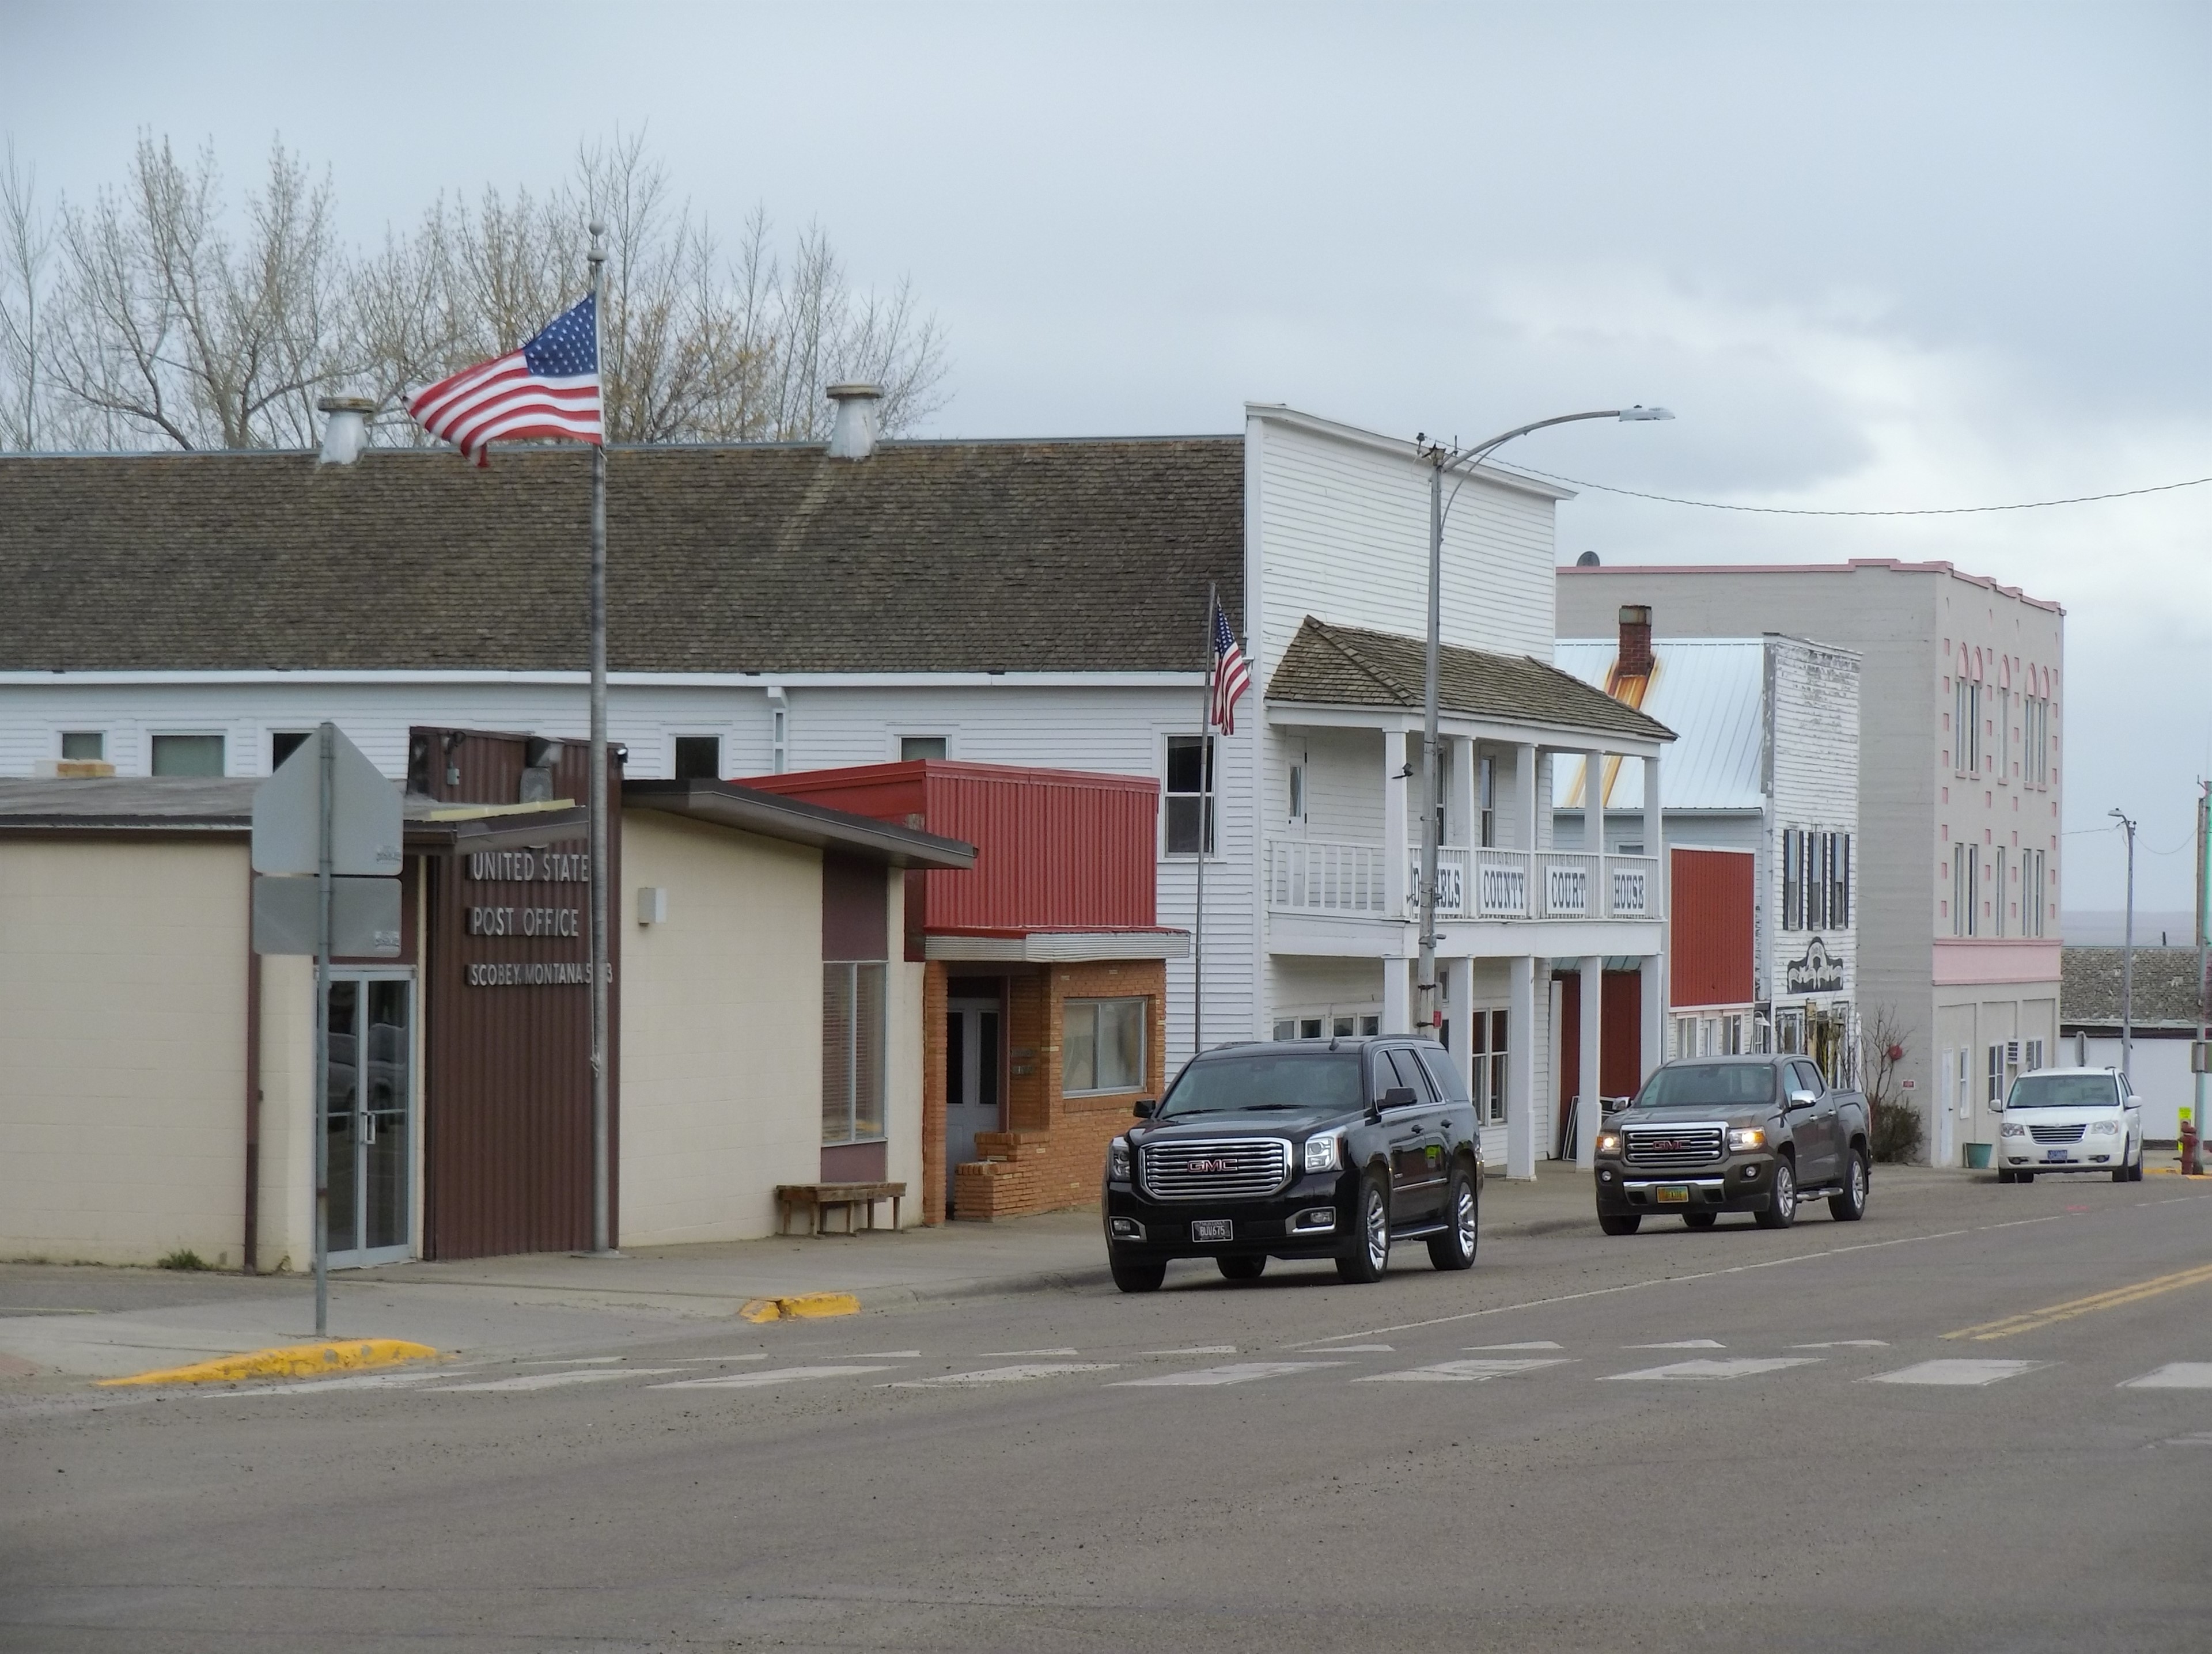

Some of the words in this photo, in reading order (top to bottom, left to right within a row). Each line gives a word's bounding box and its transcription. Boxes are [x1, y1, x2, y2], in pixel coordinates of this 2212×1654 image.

[473, 852, 535, 881] UNITED
[543, 854, 589, 882] STATE
[1483, 870, 1524, 909] COUNTY
[1552, 871, 1585, 908] COURT
[1613, 874, 1643, 909] HOUSE
[473, 906, 514, 936] POST
[523, 908, 579, 937] OFFICE
[524, 963, 582, 985] MONTANA
[1653, 1140, 1691, 1150] GMC
[1188, 1159, 1238, 1173] GMC
[1200, 1226, 1225, 1236] BUV675
